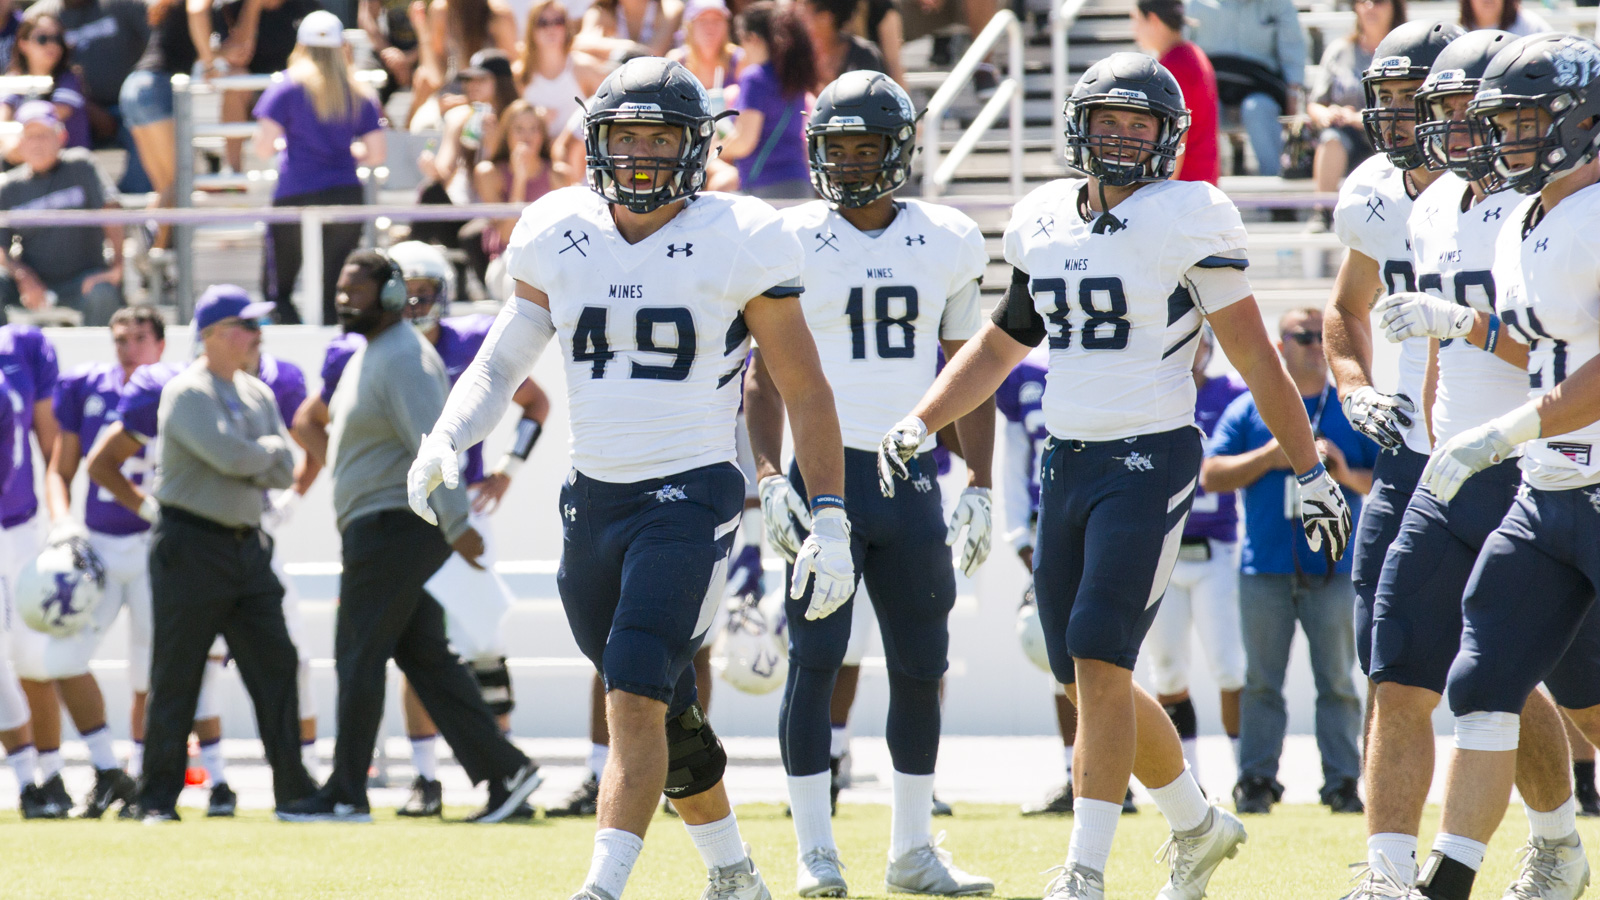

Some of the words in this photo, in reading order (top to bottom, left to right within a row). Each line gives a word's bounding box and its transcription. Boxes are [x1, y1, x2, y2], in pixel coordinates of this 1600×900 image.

[866, 268, 894, 279] MINES
[1064, 258, 1089, 271] MINES
[608, 284, 643, 299] MINES
[1032, 276, 1131, 350] 38
[572, 304, 698, 382] 49
[844, 285, 919, 360] 18
